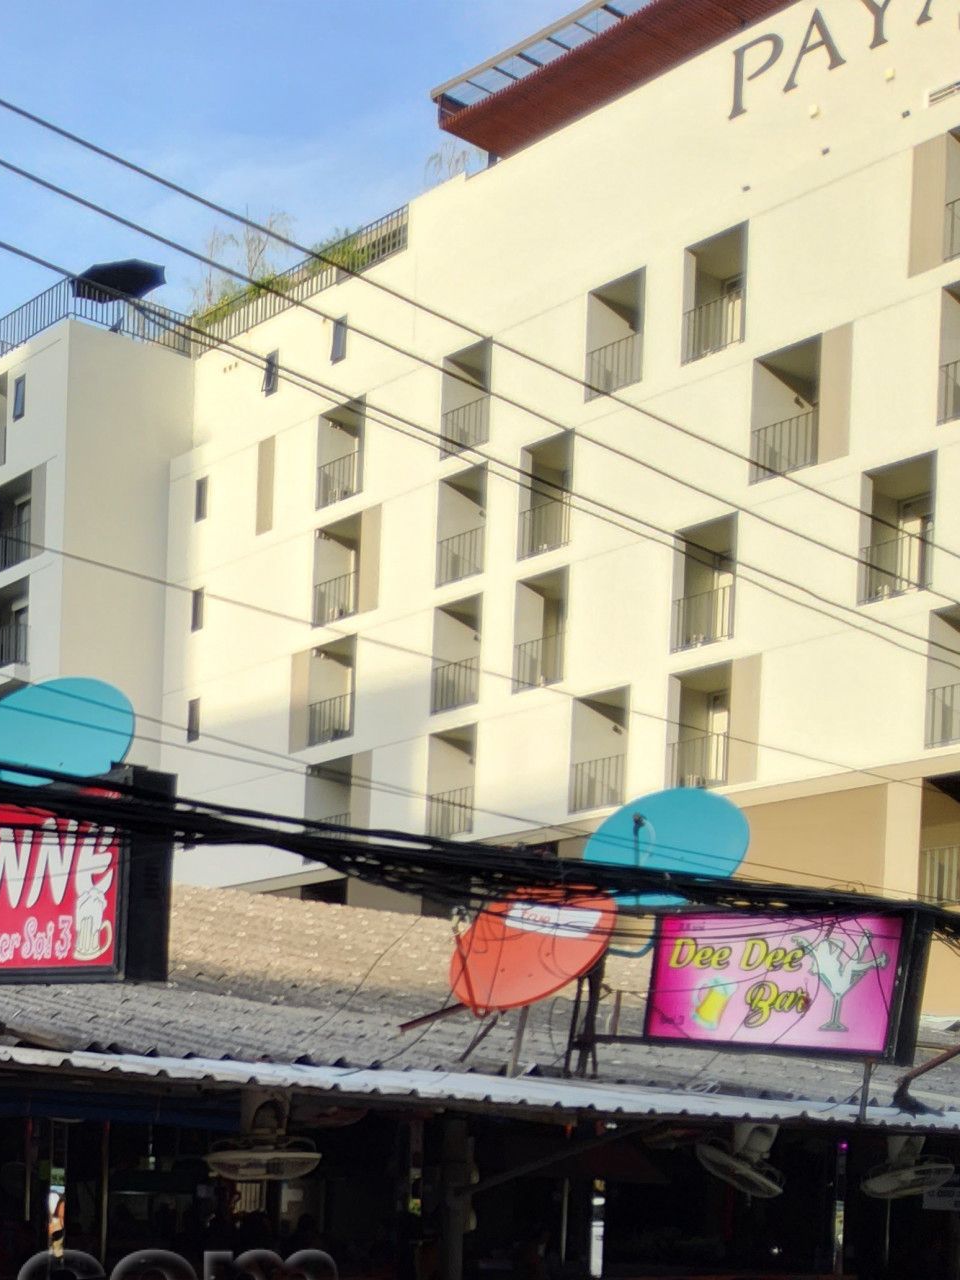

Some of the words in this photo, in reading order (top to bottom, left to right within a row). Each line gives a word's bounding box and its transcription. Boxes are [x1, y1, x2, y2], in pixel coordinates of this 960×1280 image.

[21, 916, 54, 960] Soi
[55, 915, 73, 960] 3
[668, 937, 730, 971] Dee
[738, 938, 804, 972] Dee
[743, 980, 810, 1029] Bar
